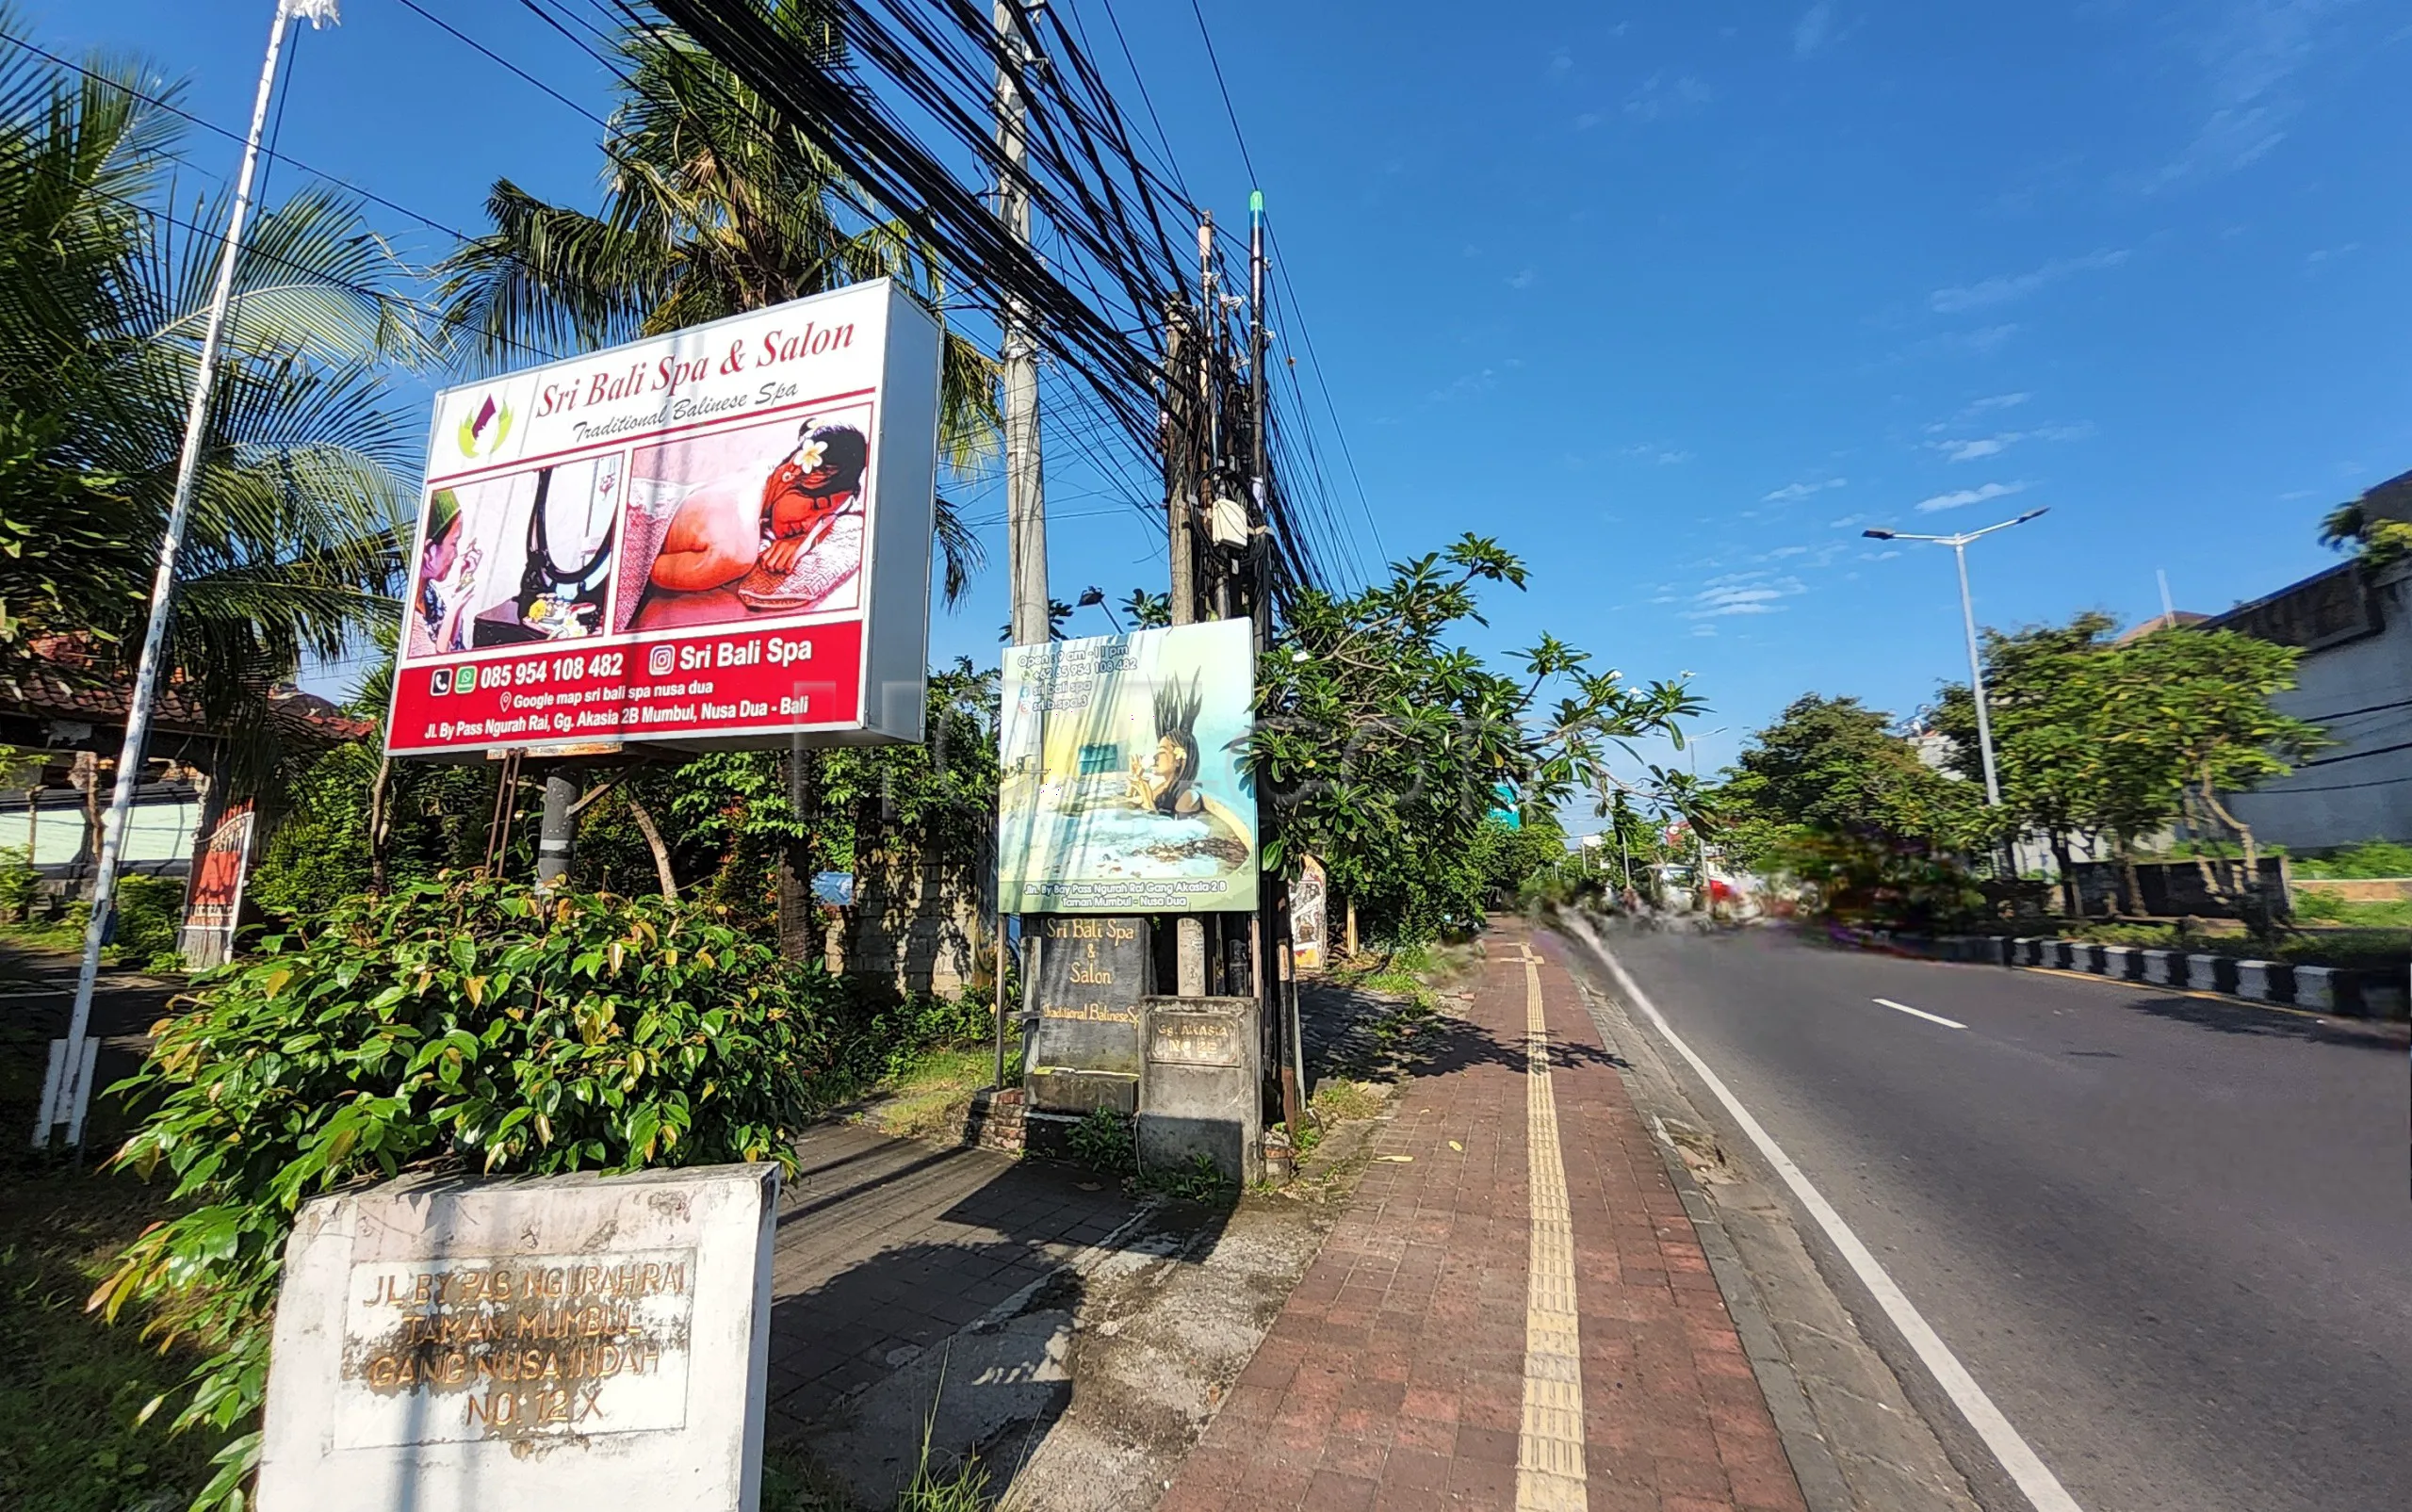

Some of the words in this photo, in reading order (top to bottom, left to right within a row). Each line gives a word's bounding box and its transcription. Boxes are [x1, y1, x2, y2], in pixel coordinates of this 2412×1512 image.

[536, 379, 580, 418] Sri
[583, 362, 646, 407] Bali
[651, 354, 709, 397] Spa
[720, 339, 745, 375] &
[756, 321, 854, 368] Salon
[573, 404, 667, 442] Traditional
[674, 394, 747, 420] Balinese
[755, 382, 798, 405] Spa
[679, 644, 711, 670] Sri
[717, 640, 760, 667] Bali
[766, 637, 812, 667] Spa
[1018, 655, 1050, 668] Open
[1067, 650, 1085, 661] am
[1109, 644, 1129, 658] pm
[481, 665, 512, 689] 085
[514, 660, 546, 685] 954
[553, 657, 584, 681] 108
[588, 653, 624, 677] 482
[1033, 668, 1053, 679] +62
[1070, 663, 1091, 675] 954
[1095, 660, 1114, 674] 108
[1116, 658, 1137, 671] 482
[513, 691, 553, 709] Google
[557, 692, 581, 707] map
[584, 688, 601, 701] sri
[603, 686, 626, 700] bali
[627, 686, 651, 701] spa
[654, 683, 685, 697] nusa
[689, 680, 713, 694] dua
[1033, 682, 1045, 696] sri
[1047, 681, 1068, 693] bali
[1069, 681, 1092, 692] spa
[439, 723, 453, 740] By
[456, 721, 482, 737] Pass
[485, 718, 526, 739] Ngurah
[529, 715, 550, 735] Rai,
[554, 712, 574, 732] Gg.
[577, 709, 618, 727] Akasia
[621, 707, 639, 723] 2B
[642, 704, 697, 723] Mumbul,
[701, 702, 736, 720] Nusa
[740, 700, 768, 717] Dua
[780, 695, 808, 715] Bali
[1041, 883, 1053, 896] By
[1053, 883, 1070, 896] Bay
[1072, 883, 1092, 894] Pass
[1094, 882, 1128, 897] Ngurah
[1130, 882, 1144, 893] Rai
[1146, 882, 1172, 895] Gang
[1176, 881, 1209, 893] Akasia
[1211, 881, 1218, 892] 2
[1061, 896, 1092, 907] Taman
[1094, 896, 1132, 907] Mumbul
[1139, 896, 1165, 907] Nusa
[1165, 896, 1187, 907] Dua
[1047, 918, 1067, 938] Sri
[1072, 919, 1103, 938] Bali
[1106, 919, 1134, 947] Spa
[1087, 943, 1096, 959] &
[1069, 961, 1112, 984] Salon
[1043, 1002, 1087, 1020] Traditional
[1089, 1003, 1129, 1022] Balinese
[415, 1270, 455, 1305] BY
[461, 1270, 512, 1303] PAS
[642, 1261, 686, 1296] RAI
[402, 1311, 502, 1344] TAMAN
[518, 1305, 643, 1341] MUMBUL
[368, 1352, 465, 1387] GANG
[475, 1348, 562, 1381] NUSA
[567, 1340, 660, 1379] INDAH
[535, 1390, 569, 1423] 12
[578, 1387, 604, 1424] X
